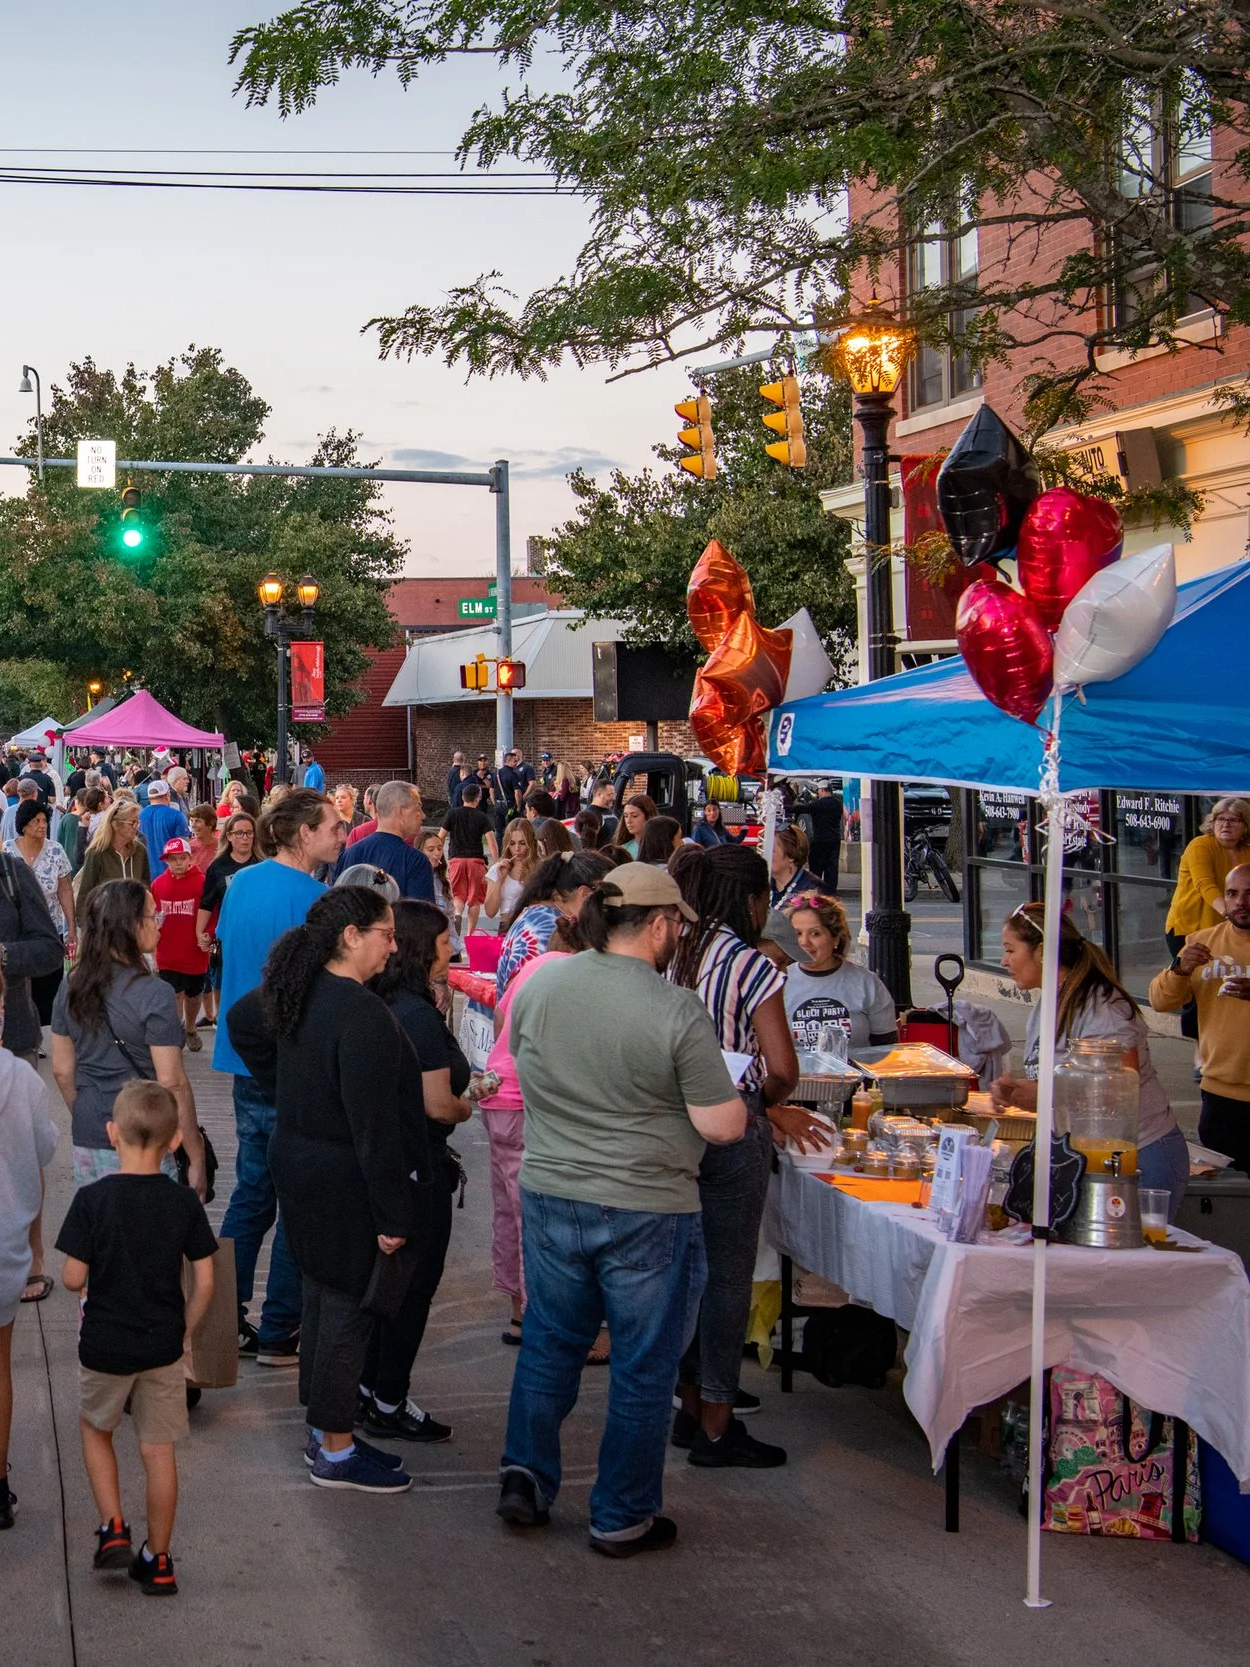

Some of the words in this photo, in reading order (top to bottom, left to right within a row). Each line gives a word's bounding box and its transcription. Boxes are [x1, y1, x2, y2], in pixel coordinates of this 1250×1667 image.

[91, 446, 102, 454] NO
[87, 455, 107, 464] TURN
[91, 465, 102, 474] ON
[88, 474, 105, 483] RED
[461, 602, 483, 614] ELM
[484, 606, 494, 614] ST
[979, 790, 995, 801] Kevin
[1116, 795, 1143, 810] Edward
[1154, 798, 1180, 814] Ritchie
[985, 805, 1020, 820] 508-643-7980
[1125, 813, 1171, 831] 508-643-6900
[796, 1008, 820, 1018] BLOCK
[822, 1007, 846, 1017] PARTY
[1085, 1462, 1165, 1510] Paris
